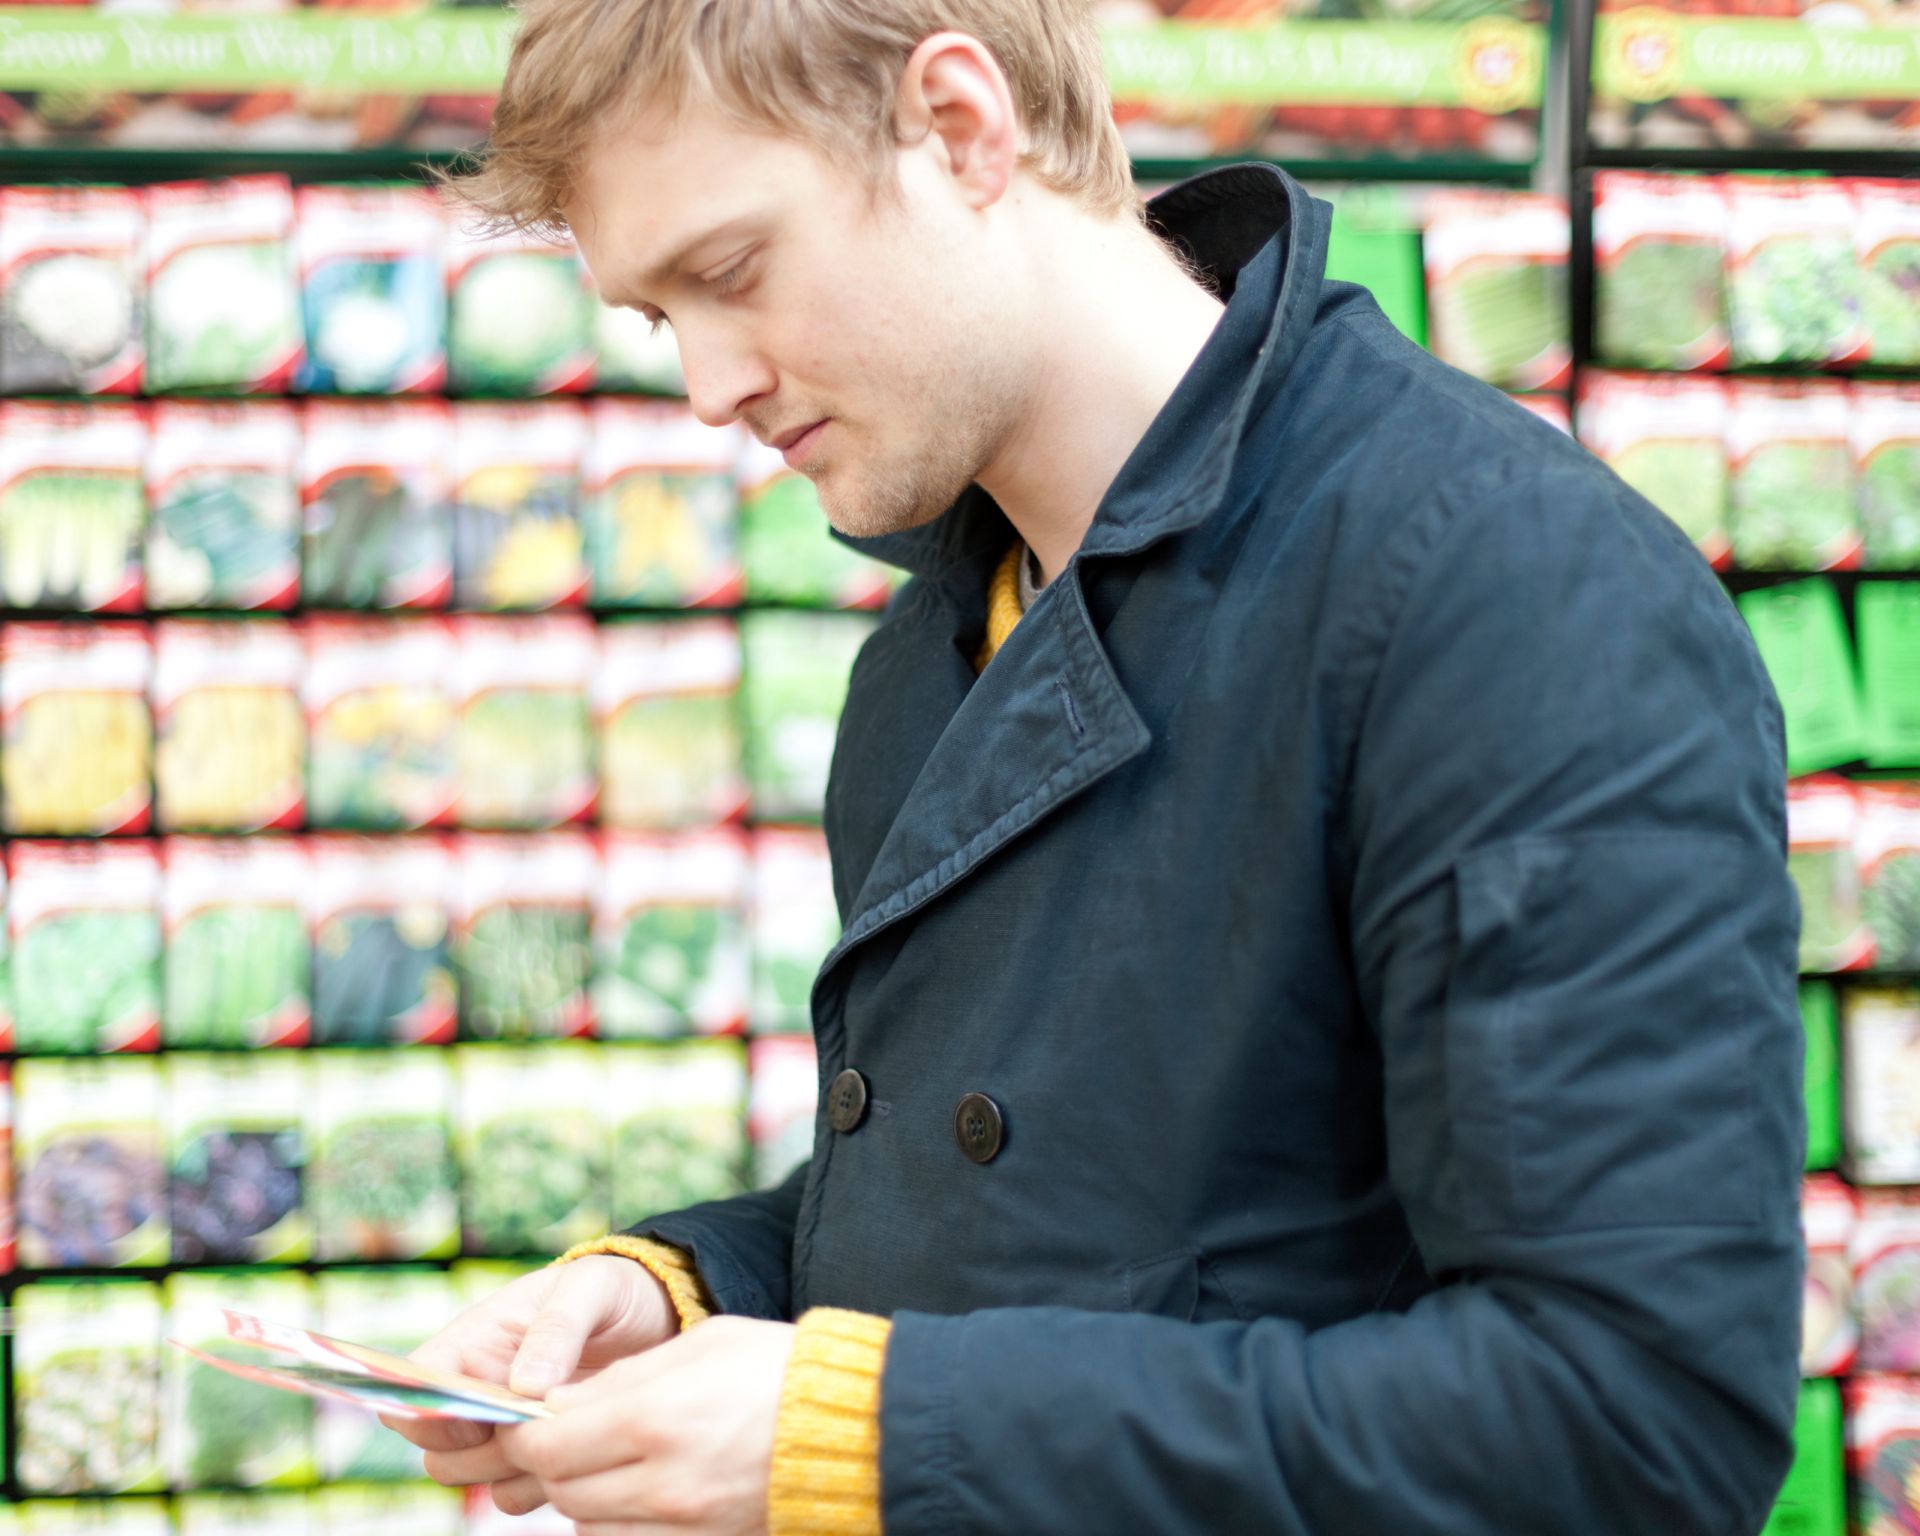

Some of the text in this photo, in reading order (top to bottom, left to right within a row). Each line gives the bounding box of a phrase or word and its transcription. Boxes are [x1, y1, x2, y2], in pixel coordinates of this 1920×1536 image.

[118, 17, 227, 72] Your
[234, 17, 338, 86] Way
[1693, 24, 1811, 77] Grow
[1815, 26, 1908, 78] Your
